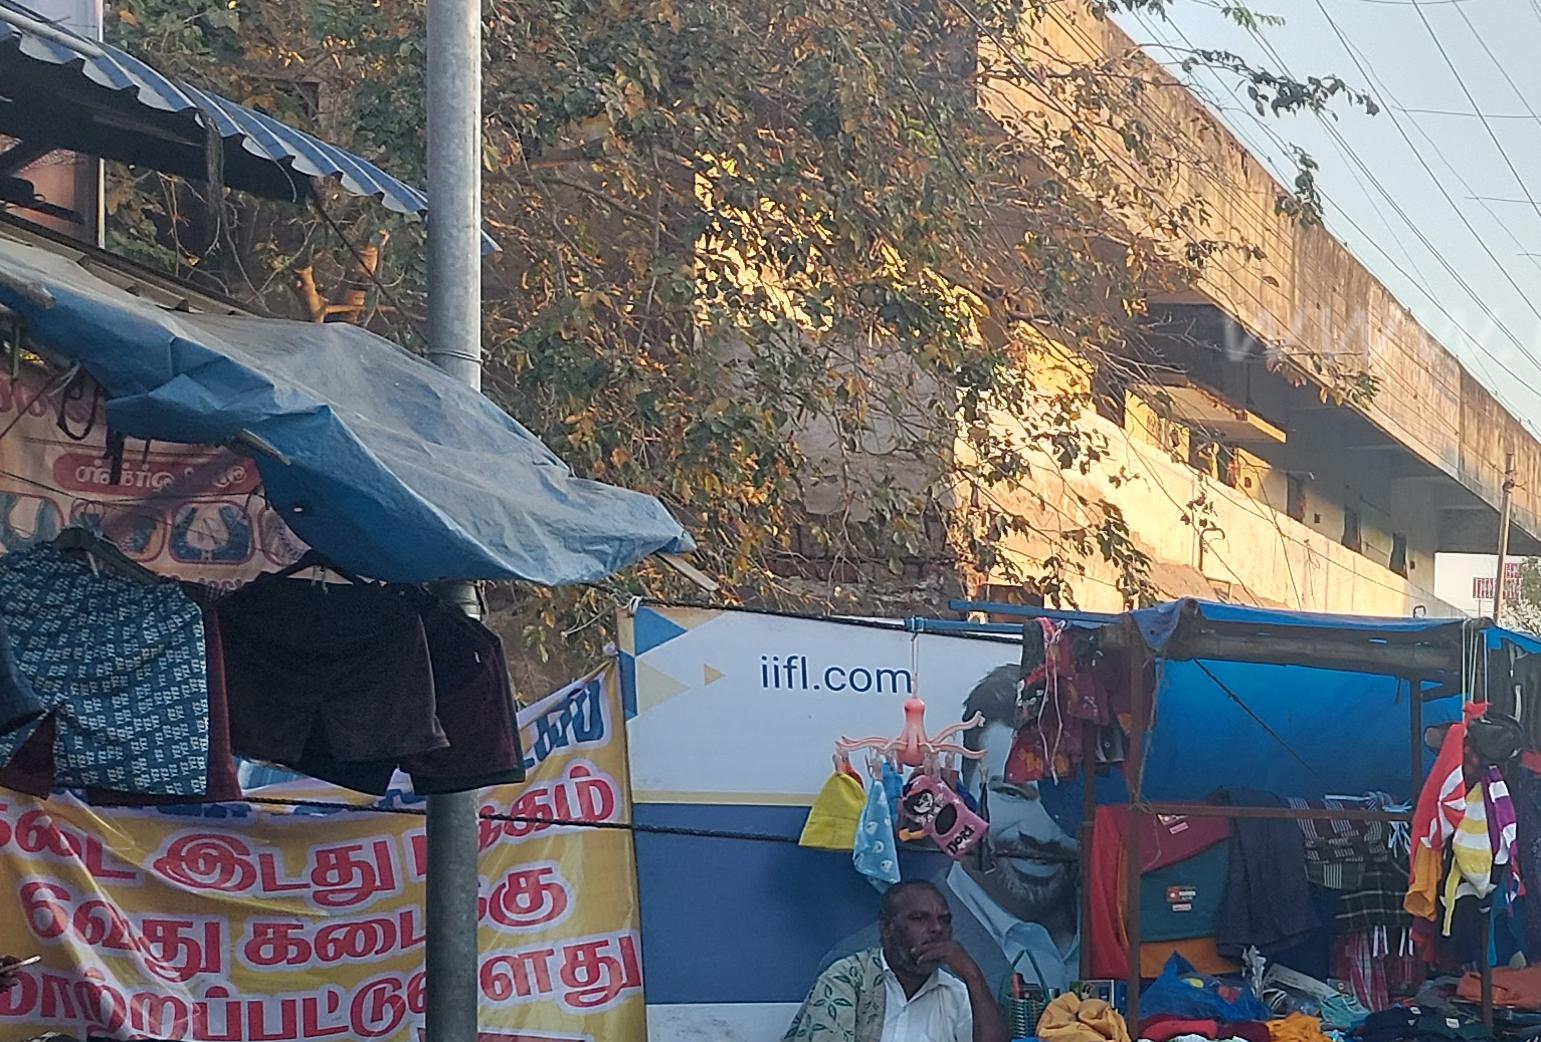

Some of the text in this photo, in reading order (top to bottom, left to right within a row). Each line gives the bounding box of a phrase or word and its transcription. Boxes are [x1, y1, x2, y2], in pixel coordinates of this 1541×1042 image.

[760, 655, 912, 694] iifl.com
[0, 804, 137, 881] டை
[153, 832, 397, 908] இடது
[244, 867, 568, 966] கடைகு
